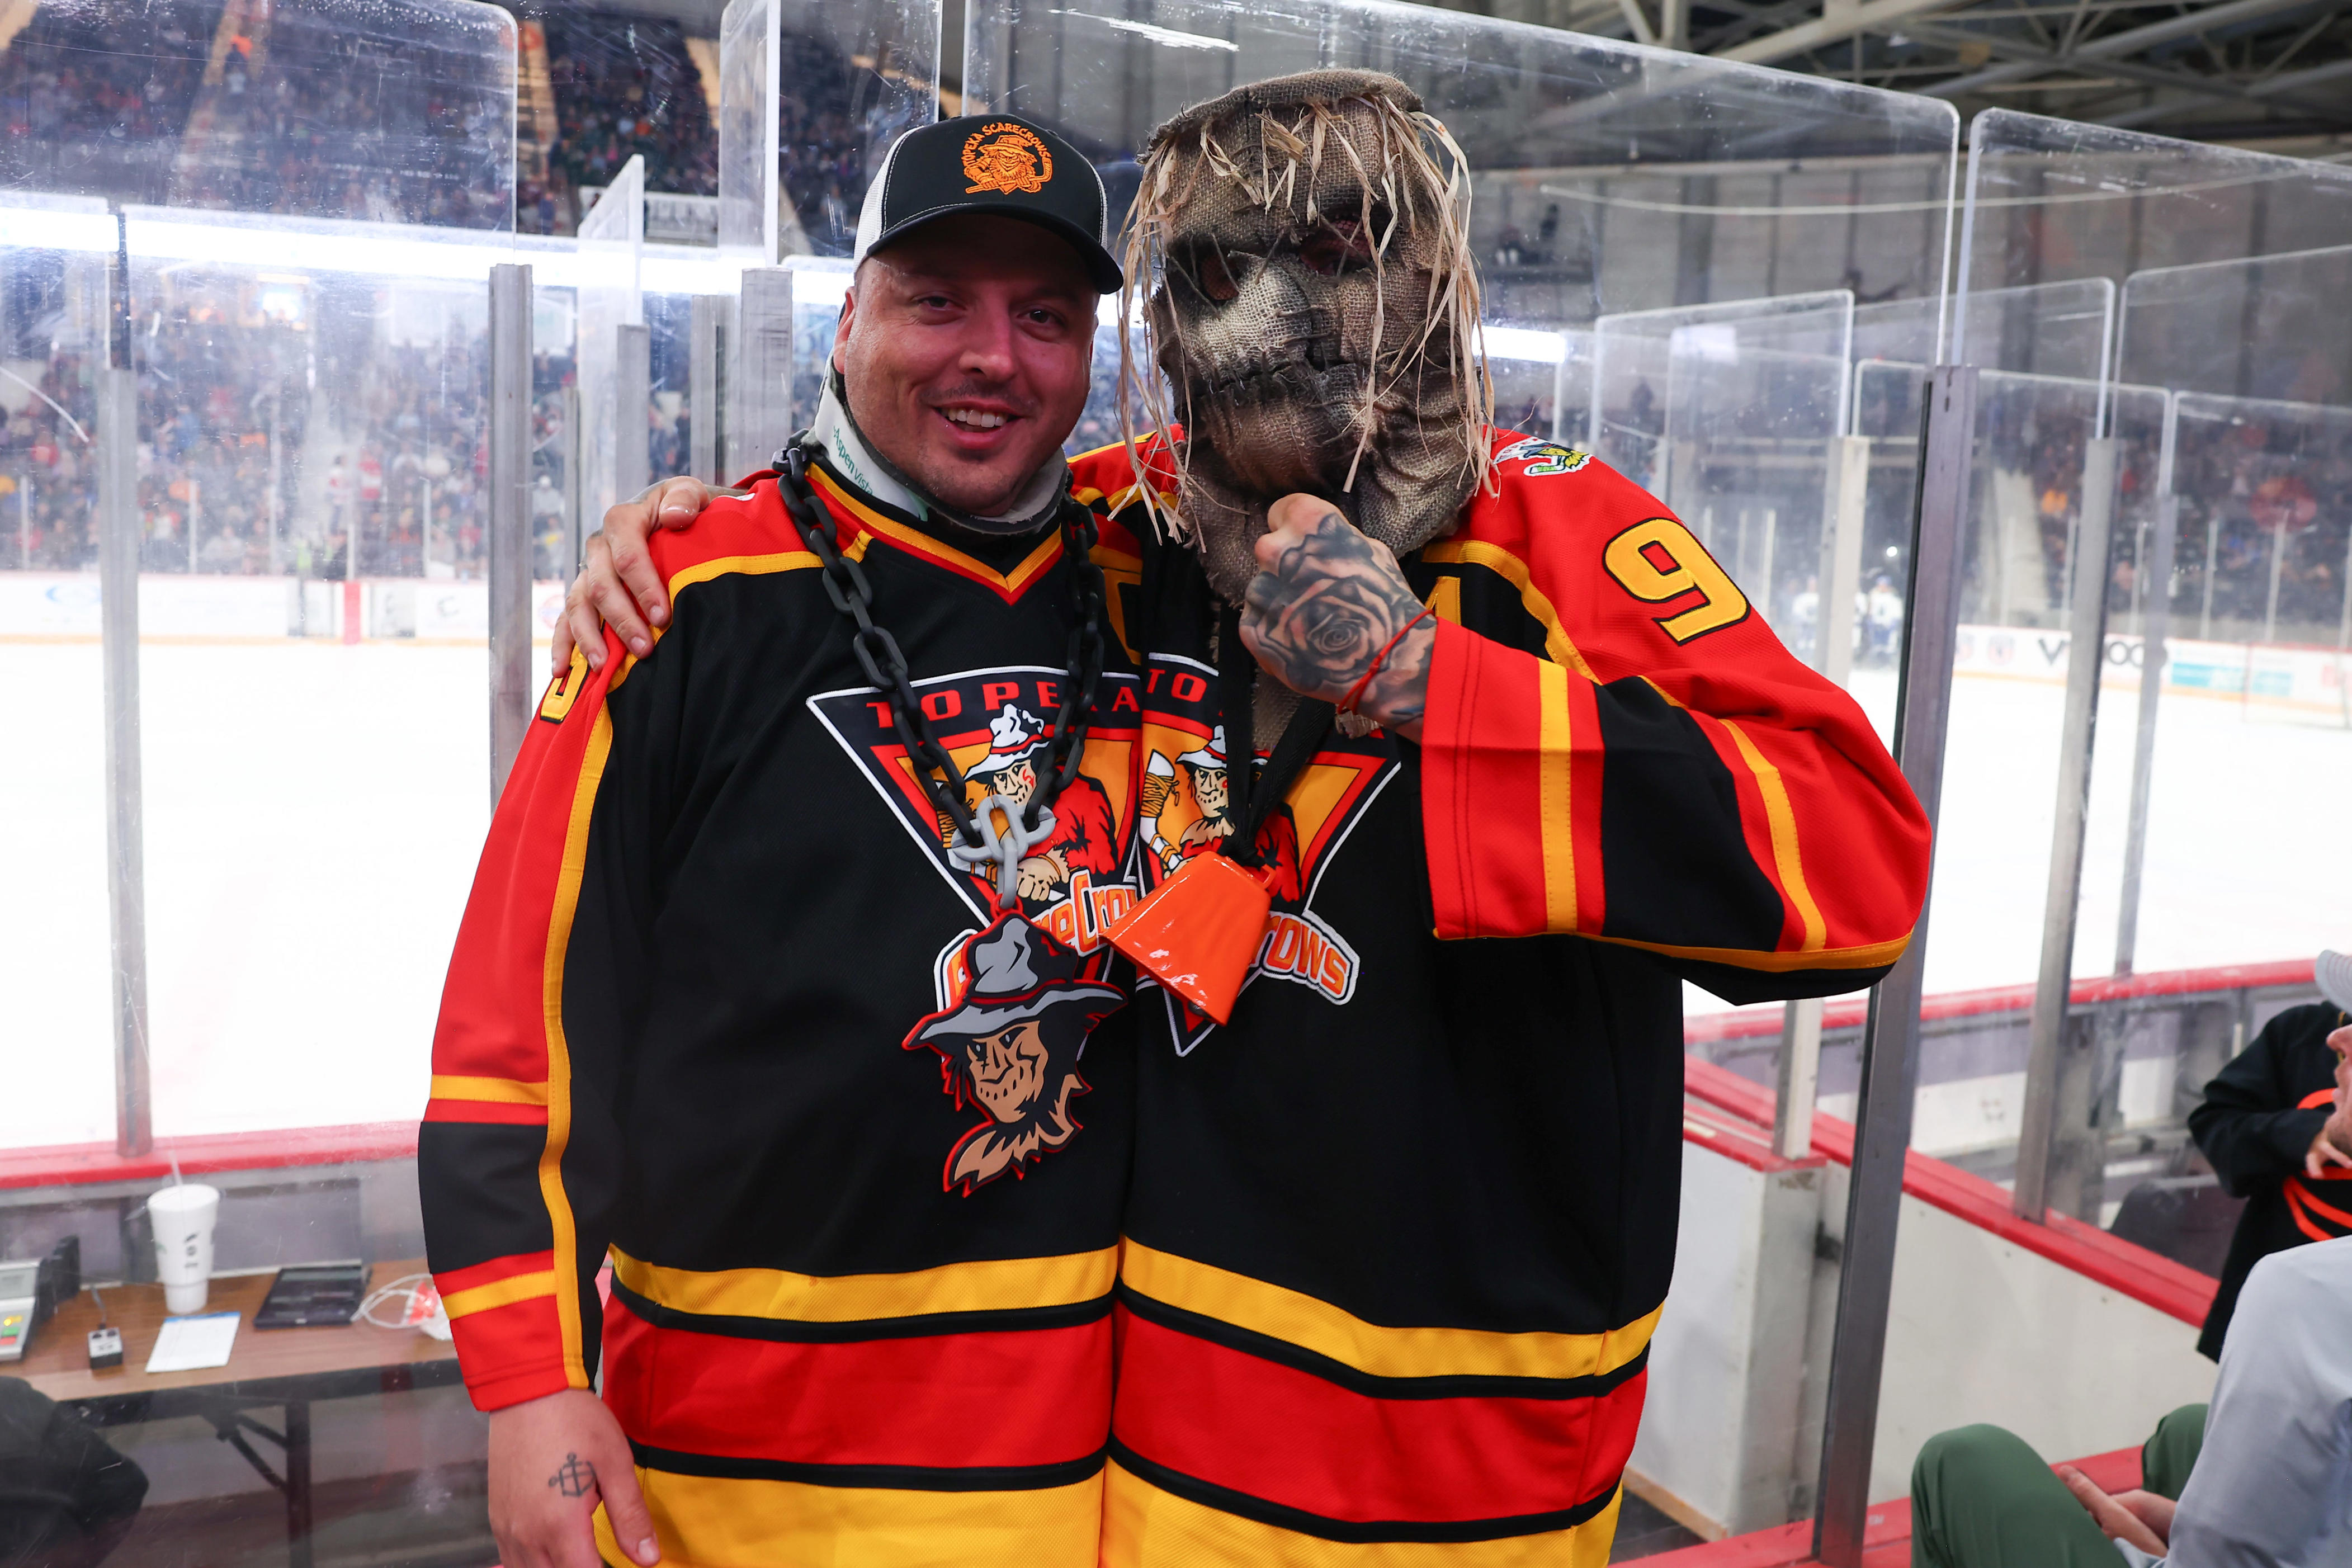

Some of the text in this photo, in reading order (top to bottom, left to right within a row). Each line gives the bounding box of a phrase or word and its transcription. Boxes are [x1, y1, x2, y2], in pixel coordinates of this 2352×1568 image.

[961, 122, 1052, 167] TOPEKA SCARECROWS
[833, 426, 873, 496] Aspen Vista
[1602, 517, 1751, 646] 9
[866, 681, 1140, 728] TOPEA
